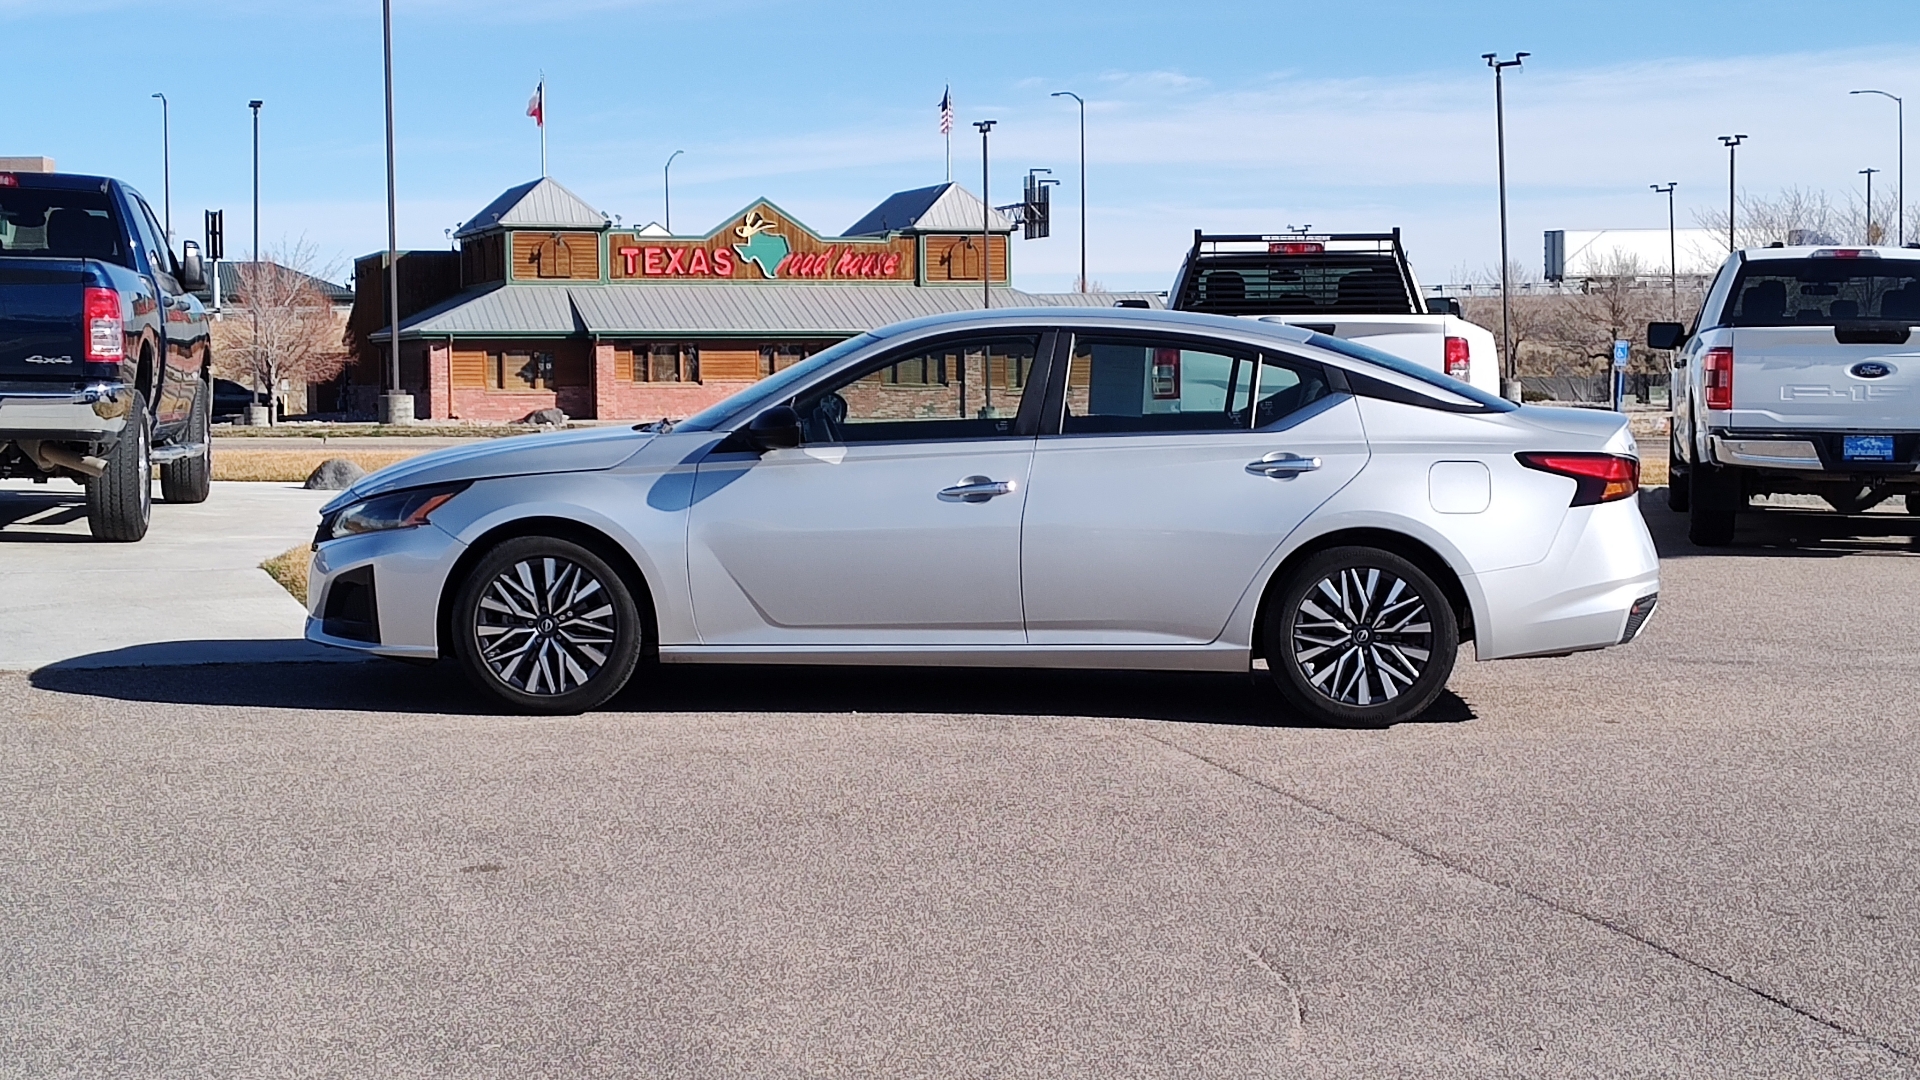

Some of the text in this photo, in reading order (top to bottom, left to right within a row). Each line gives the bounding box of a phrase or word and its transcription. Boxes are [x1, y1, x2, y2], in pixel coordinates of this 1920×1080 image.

[619, 246, 735, 277] TEXAS
[25, 355, 73, 364] 4x4
[1859, 365, 1883, 375] Ford
[1779, 384, 1919, 401] F-15
